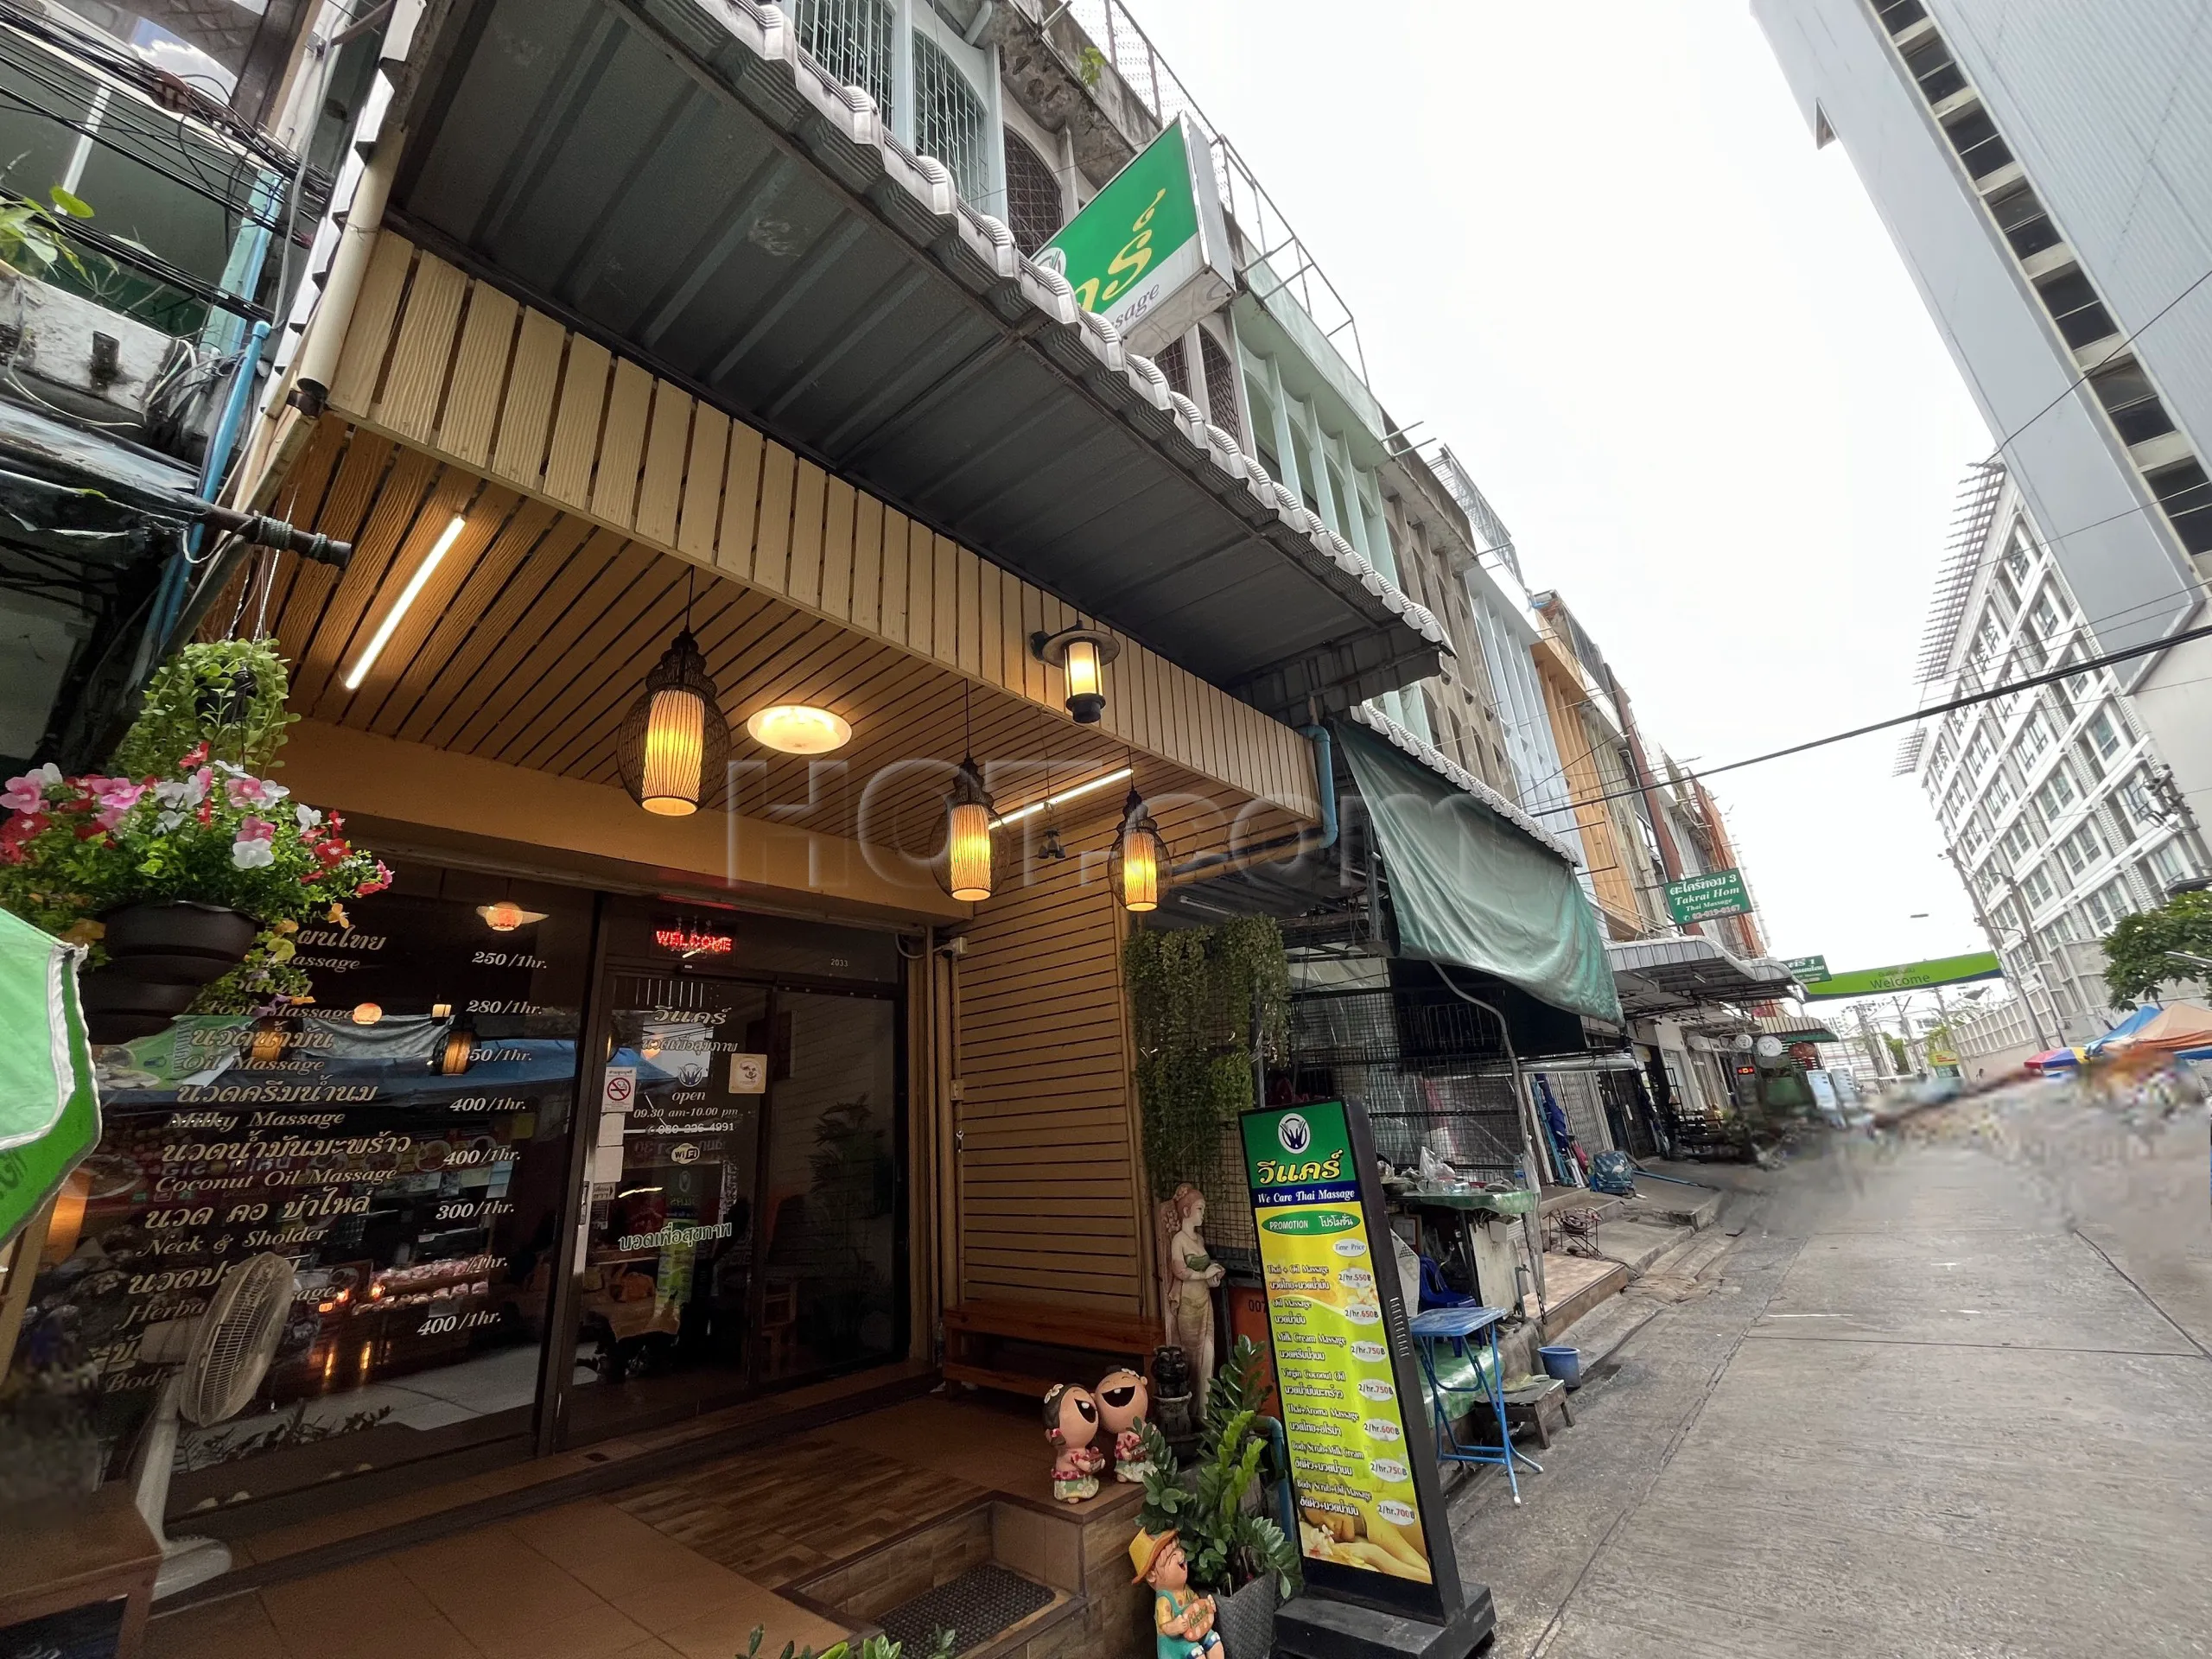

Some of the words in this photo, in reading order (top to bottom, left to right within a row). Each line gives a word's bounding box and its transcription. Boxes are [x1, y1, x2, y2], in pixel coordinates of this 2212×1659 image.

[1111, 282, 1160, 329] sage
[1675, 891, 1710, 906] Takrai
[1713, 887, 1740, 898] Hom
[1685, 902, 1702, 912] Thai
[1703, 898, 1733, 909] Massage
[655, 929, 734, 952] WELCOME
[830, 958, 849, 968] 2033
[1869, 973, 1931, 989] Welcome
[467, 998, 543, 1016] 280/1hr.
[183, 1054, 228, 1073] Oil
[229, 1055, 325, 1076] Massage
[467, 1047, 534, 1064] 50/1hr.
[177, 1076, 378, 1104] นวดครีมน้ำนม
[671, 1090, 707, 1105] open
[448, 1095, 527, 1113] 400/1hr.
[164, 1112, 240, 1133] Milky
[248, 1110, 346, 1130] Massage
[162, 1128, 411, 1166] นวดน้ำมันมะพร้าว
[443, 1147, 522, 1168] 400/1hr.
[1256, 1149, 1344, 1184] วีแคร์
[156, 1173, 254, 1194] Coconut
[264, 1168, 304, 1187] Oil
[312, 1164, 397, 1186] Massage
[1257, 1192, 1271, 1204] We
[1273, 1192, 1293, 1203] Care
[1295, 1191, 1316, 1202] Thai
[1318, 1189, 1356, 1202] Massage
[144, 1203, 213, 1231] นวด
[225, 1197, 269, 1225] คอ
[284, 1187, 372, 1222] บ่าไหล่
[435, 1200, 515, 1221] 300/1hr.
[1269, 1219, 1309, 1230] PROMOTION
[1318, 1213, 1354, 1228] โปรโมชั่น
[136, 1234, 204, 1258] Neck
[214, 1234, 234, 1254] &
[241, 1224, 329, 1249] Sholder
[465, 1254, 509, 1274] /1hr.
[1267, 1264, 1281, 1274] Thai
[1290, 1264, 1300, 1274] Oil
[1302, 1264, 1330, 1275] Massage
[1272, 1299, 1283, 1308] Oil
[1285, 1299, 1313, 1310] Massage
[113, 1298, 207, 1332] Herba
[416, 1311, 502, 1338] 400/1hr.
[1276, 1332, 1293, 1343] Milk
[1294, 1333, 1316, 1344] Cream
[1318, 1333, 1347, 1347] Massage
[1281, 1367, 1303, 1380] Virgin
[1303, 1369, 1332, 1381] Coconut
[1333, 1371, 1346, 1382] Oil
[1287, 1402, 1329, 1417] Thai+Aroma
[1330, 1408, 1360, 1421] Massage
[1291, 1440, 1307, 1455] Body
[1343, 1447, 1365, 1460] Cream
[1296, 1478, 1313, 1493] Body
[1346, 1487, 1372, 1503] Massage
